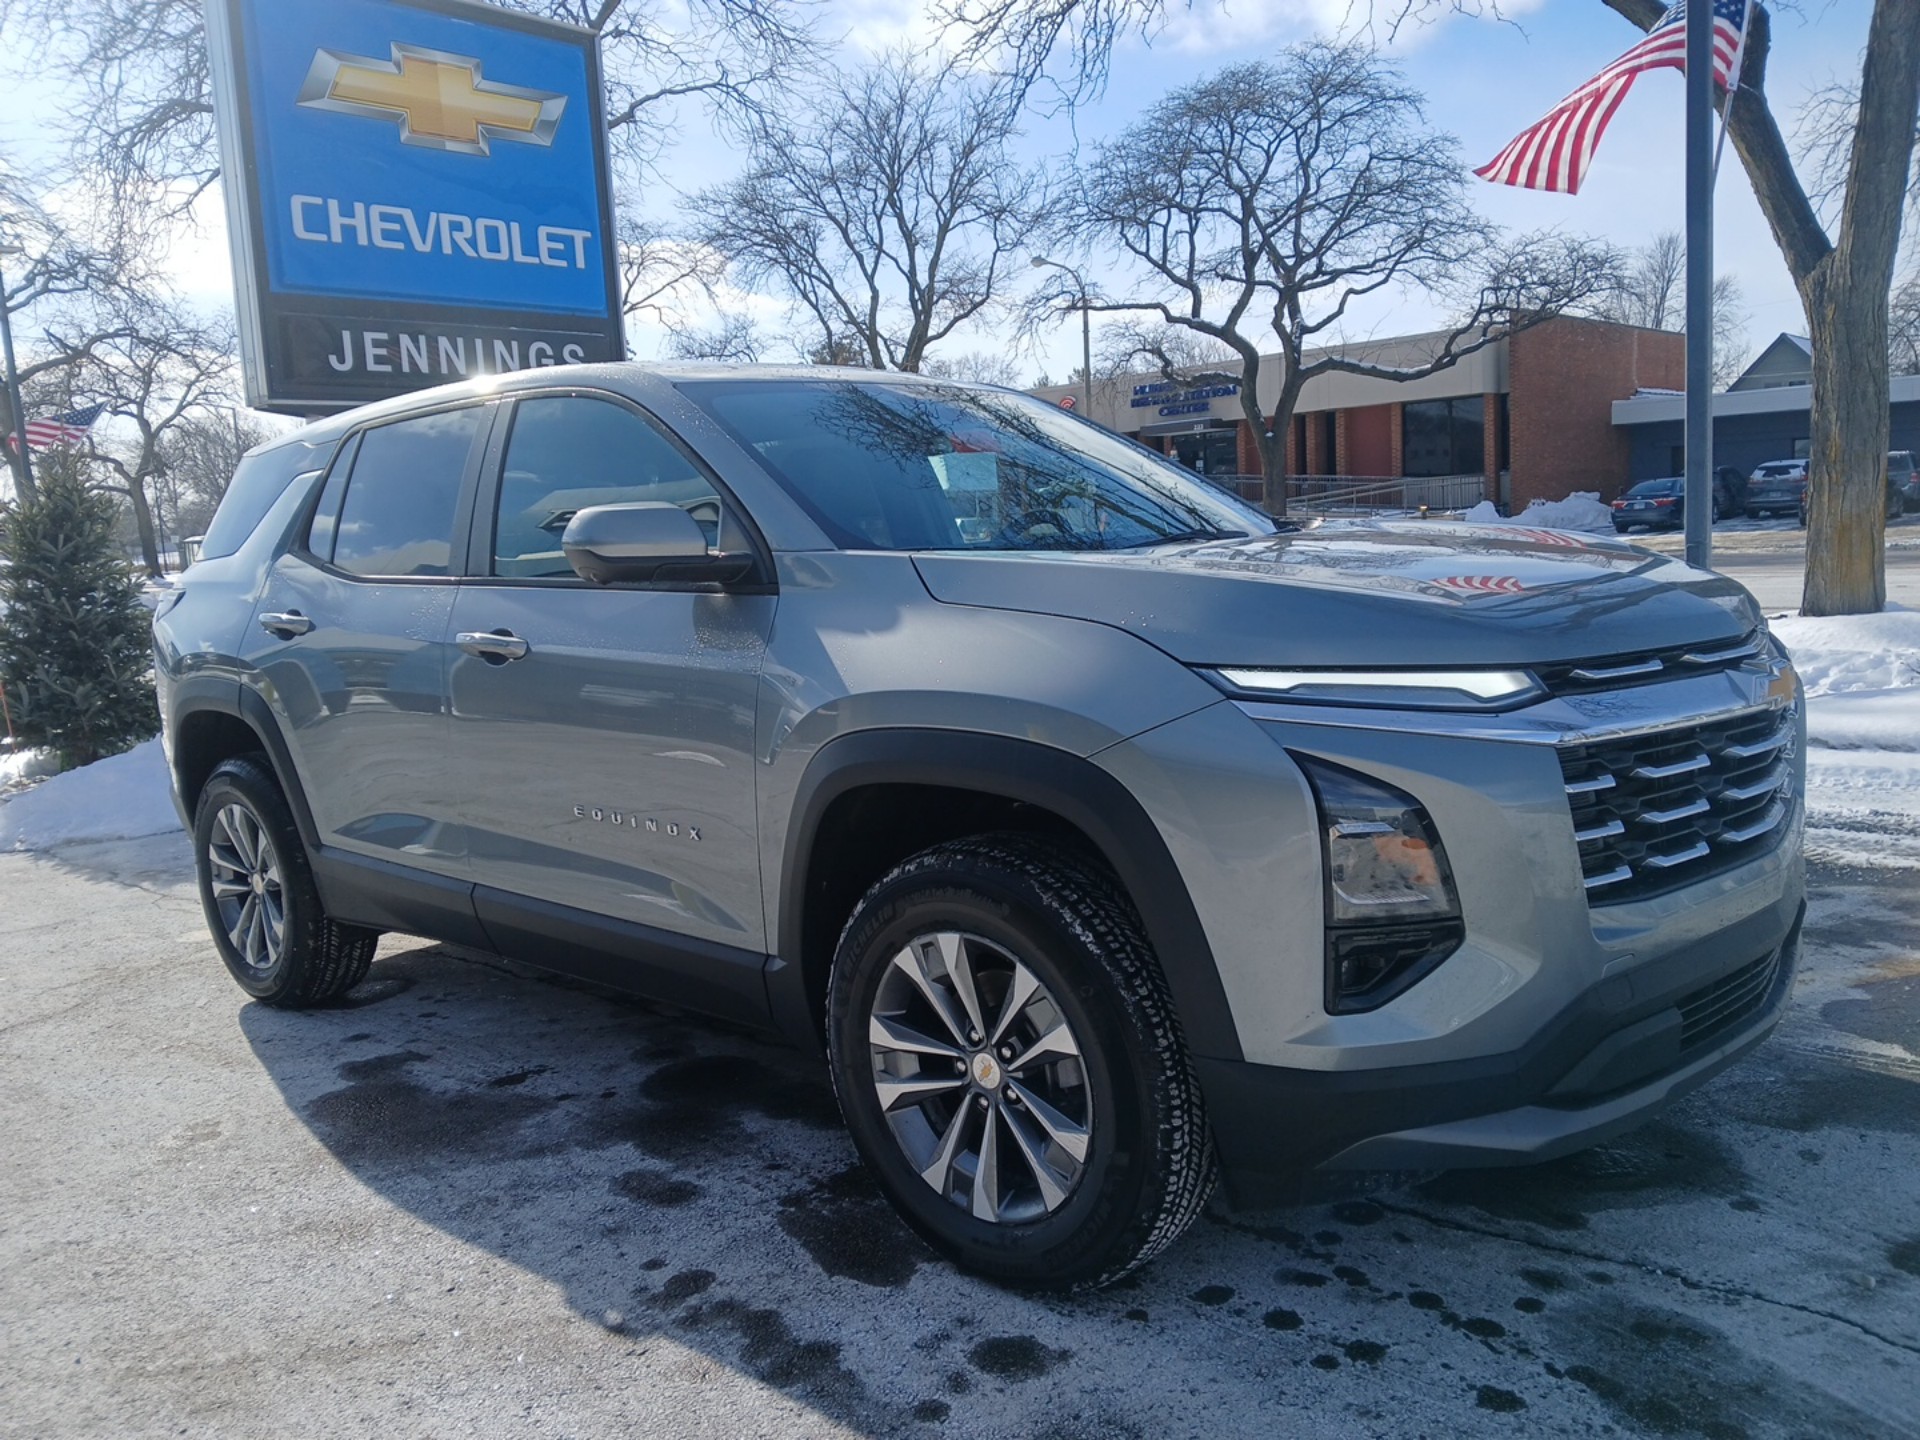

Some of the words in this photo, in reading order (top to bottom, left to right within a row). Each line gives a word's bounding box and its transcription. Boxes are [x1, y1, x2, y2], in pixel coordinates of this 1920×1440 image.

[290, 194, 592, 269] CHEVROLET
[328, 330, 584, 375] JENNINGS
[573, 804, 701, 841] EQUINOX
